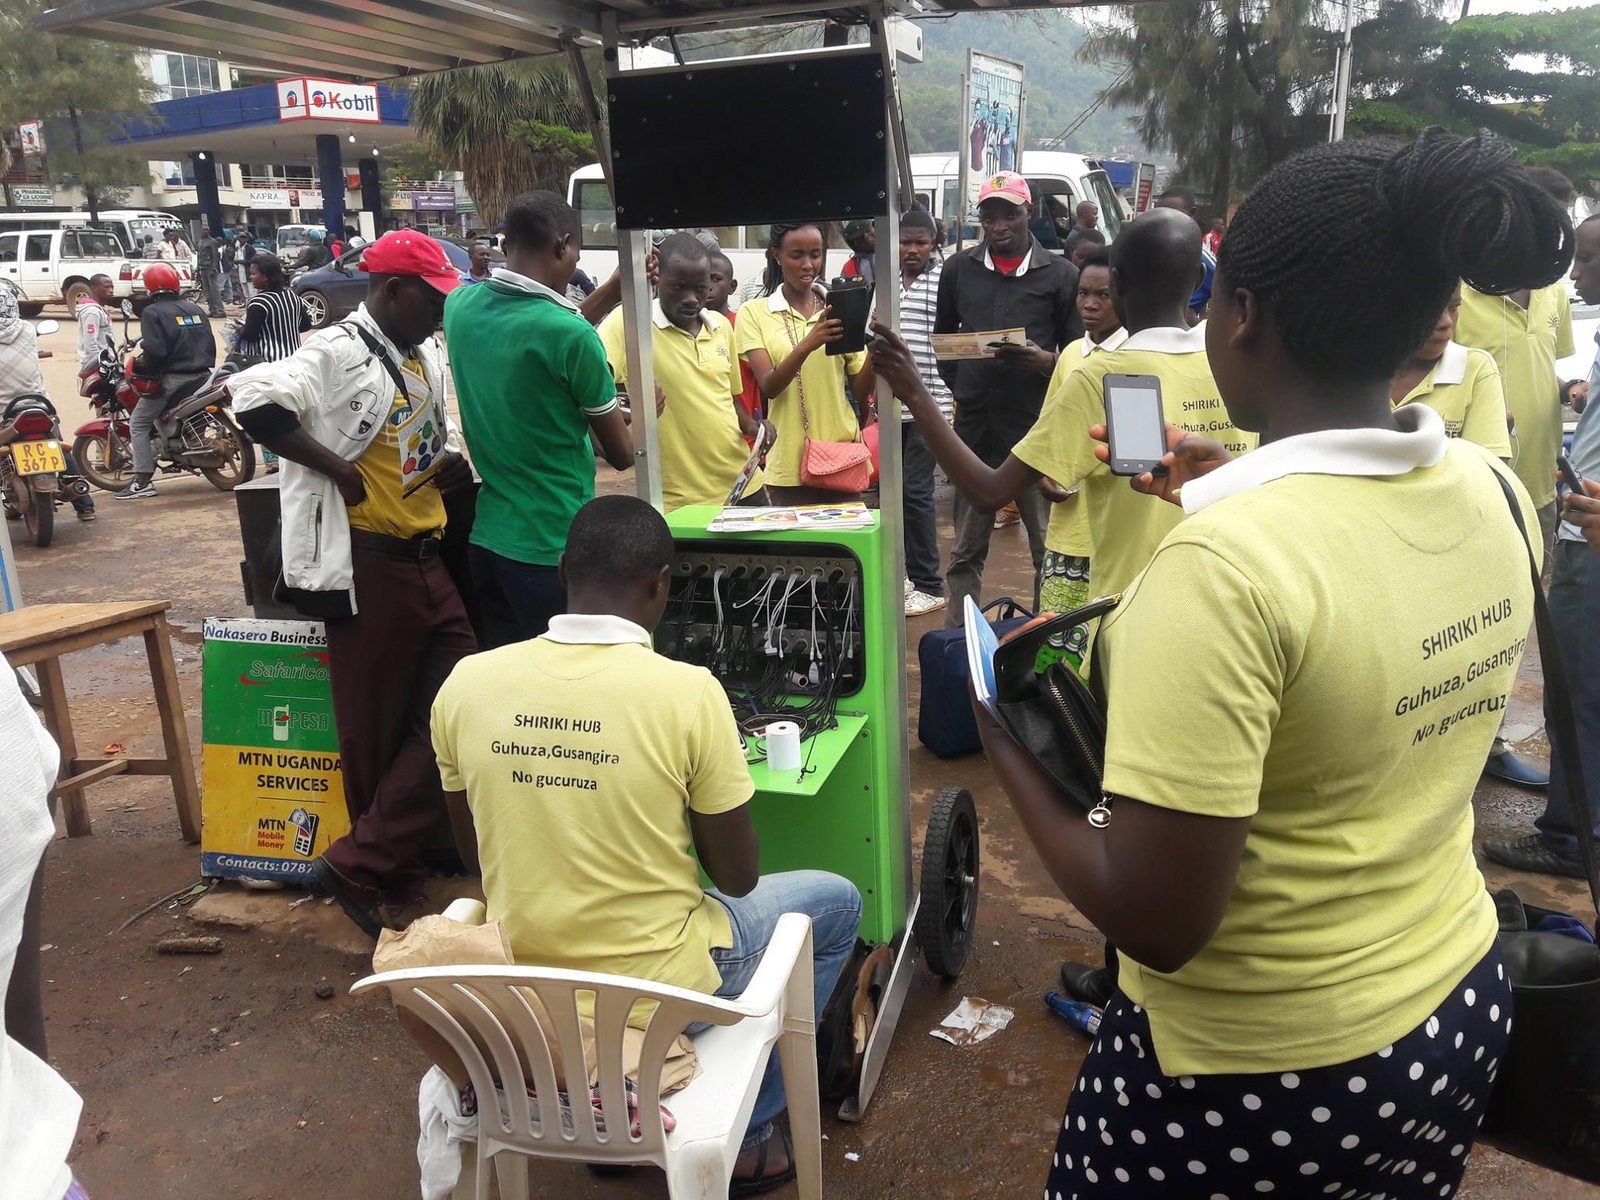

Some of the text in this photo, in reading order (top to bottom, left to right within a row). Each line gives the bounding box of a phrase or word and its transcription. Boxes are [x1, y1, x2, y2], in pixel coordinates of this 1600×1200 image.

[329, 91, 375, 112] Kobil
[141, 220, 178, 230] ALPHA
[87, 324, 95, 334] 5
[1182, 398, 1220, 411] SHIRIKI
[204, 626, 328, 645] Nakasero Business
[1422, 598, 1513, 660] SHIRIKI HUB
[250, 660, 330, 681] Safarico
[513, 714, 601, 734] SHIRIKI HUB
[1412, 693, 1507, 746] No gucuruz
[238, 752, 343, 771] MTN UGANDA
[257, 774, 329, 792] SERVICES
[512, 770, 598, 791] No gucuruza
[258, 818, 286, 831] MTN
[257, 831, 285, 841] Mobile
[257, 840, 285, 850] Money
[216, 855, 280, 871] Contacts:
